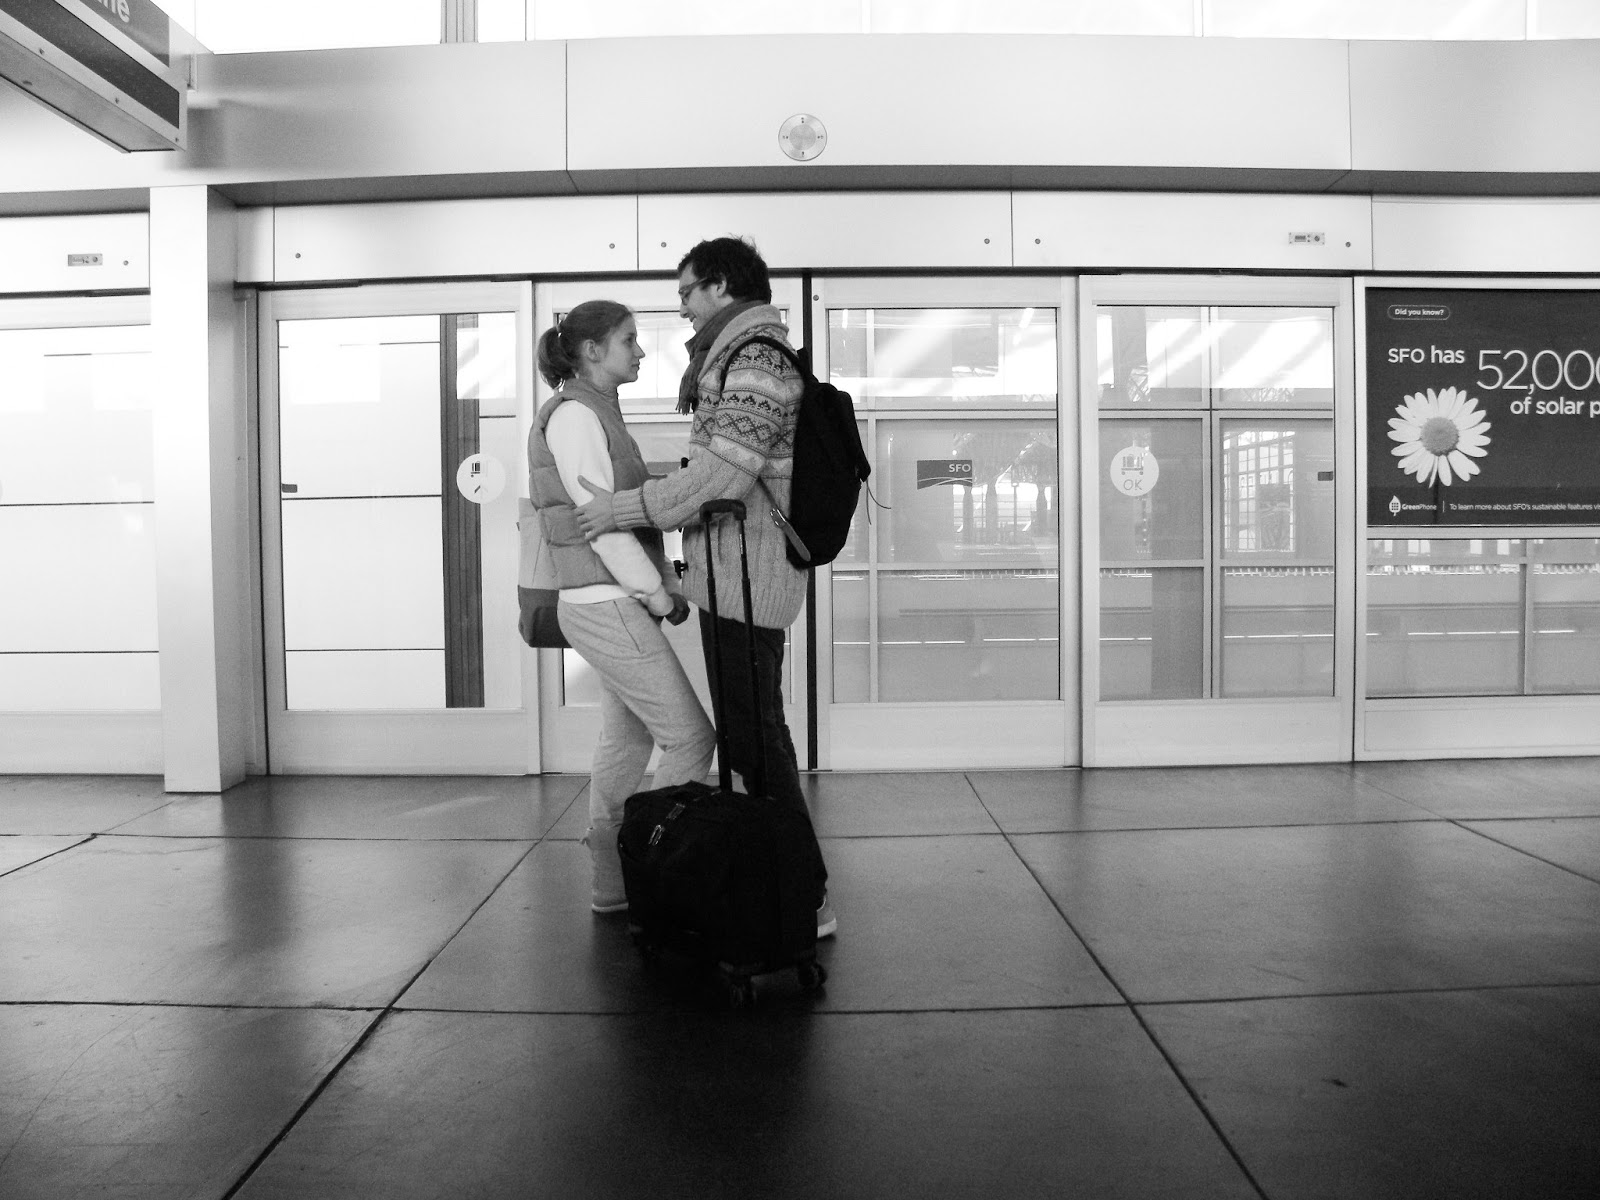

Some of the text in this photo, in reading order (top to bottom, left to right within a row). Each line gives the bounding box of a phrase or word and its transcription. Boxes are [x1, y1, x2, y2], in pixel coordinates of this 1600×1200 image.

[1408, 308, 1421, 316] you
[1388, 345, 1600, 394] SFO has 52,00
[1510, 396, 1532, 414] of
[1536, 396, 1585, 414] solar
[948, 463, 971, 472] SFO
[1123, 479, 1143, 490] OK
